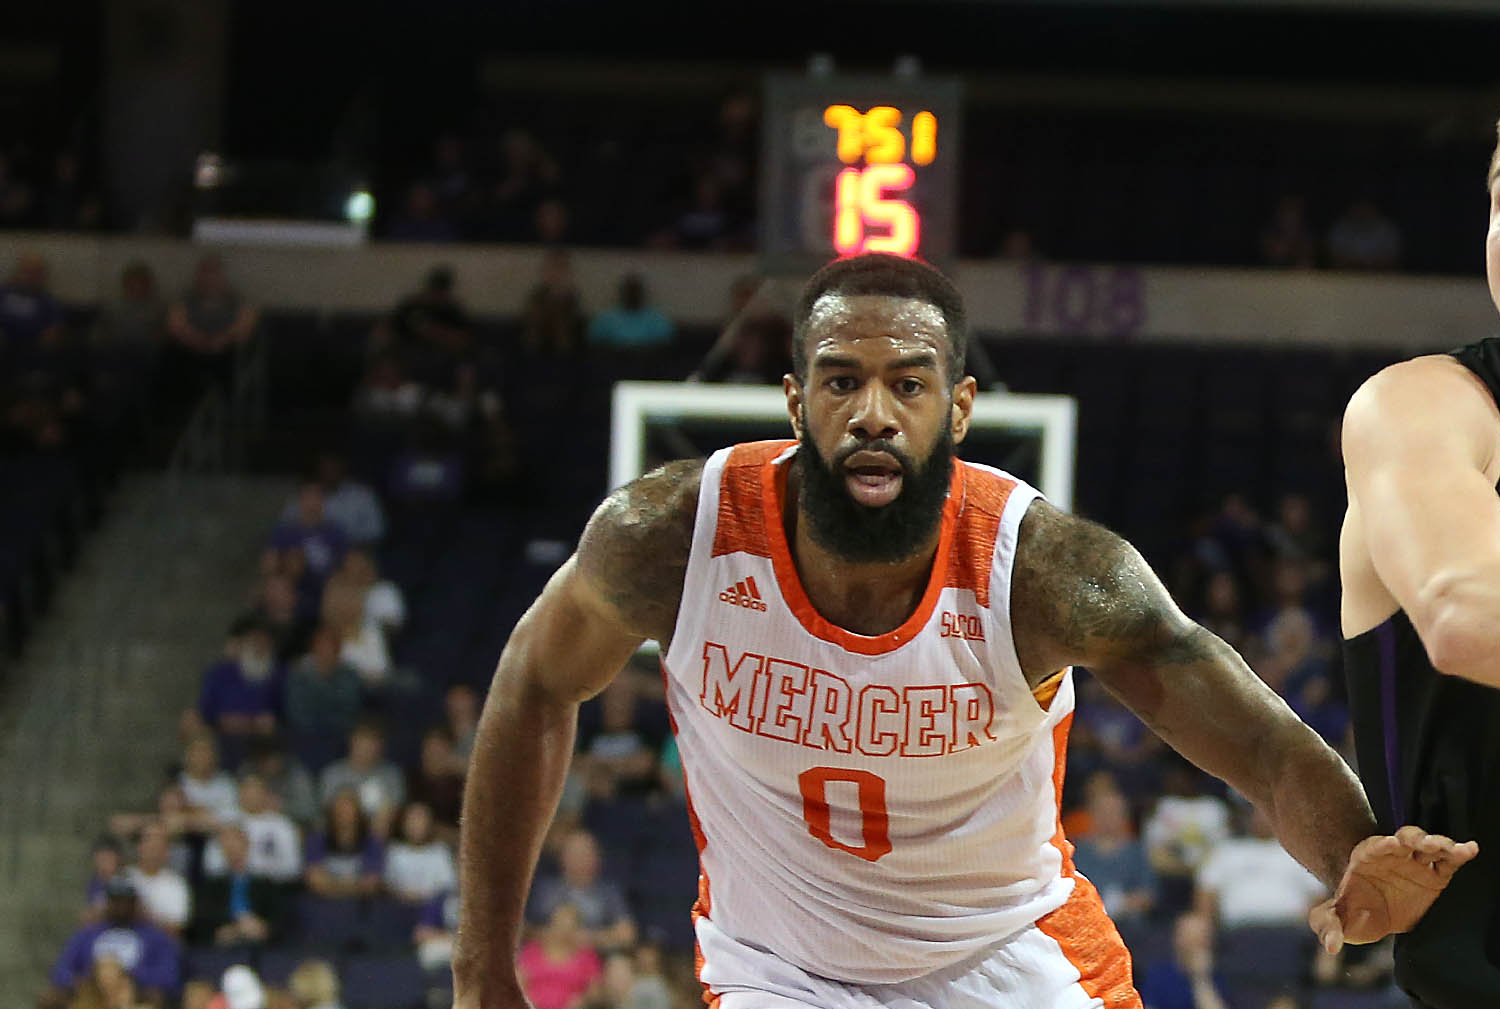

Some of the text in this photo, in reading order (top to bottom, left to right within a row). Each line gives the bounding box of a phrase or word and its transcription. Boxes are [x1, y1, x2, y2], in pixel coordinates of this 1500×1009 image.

[834, 163, 920, 256] 15
[719, 592, 767, 612] adidas
[701, 641, 997, 757] MERCER
[798, 766, 893, 862] 0
